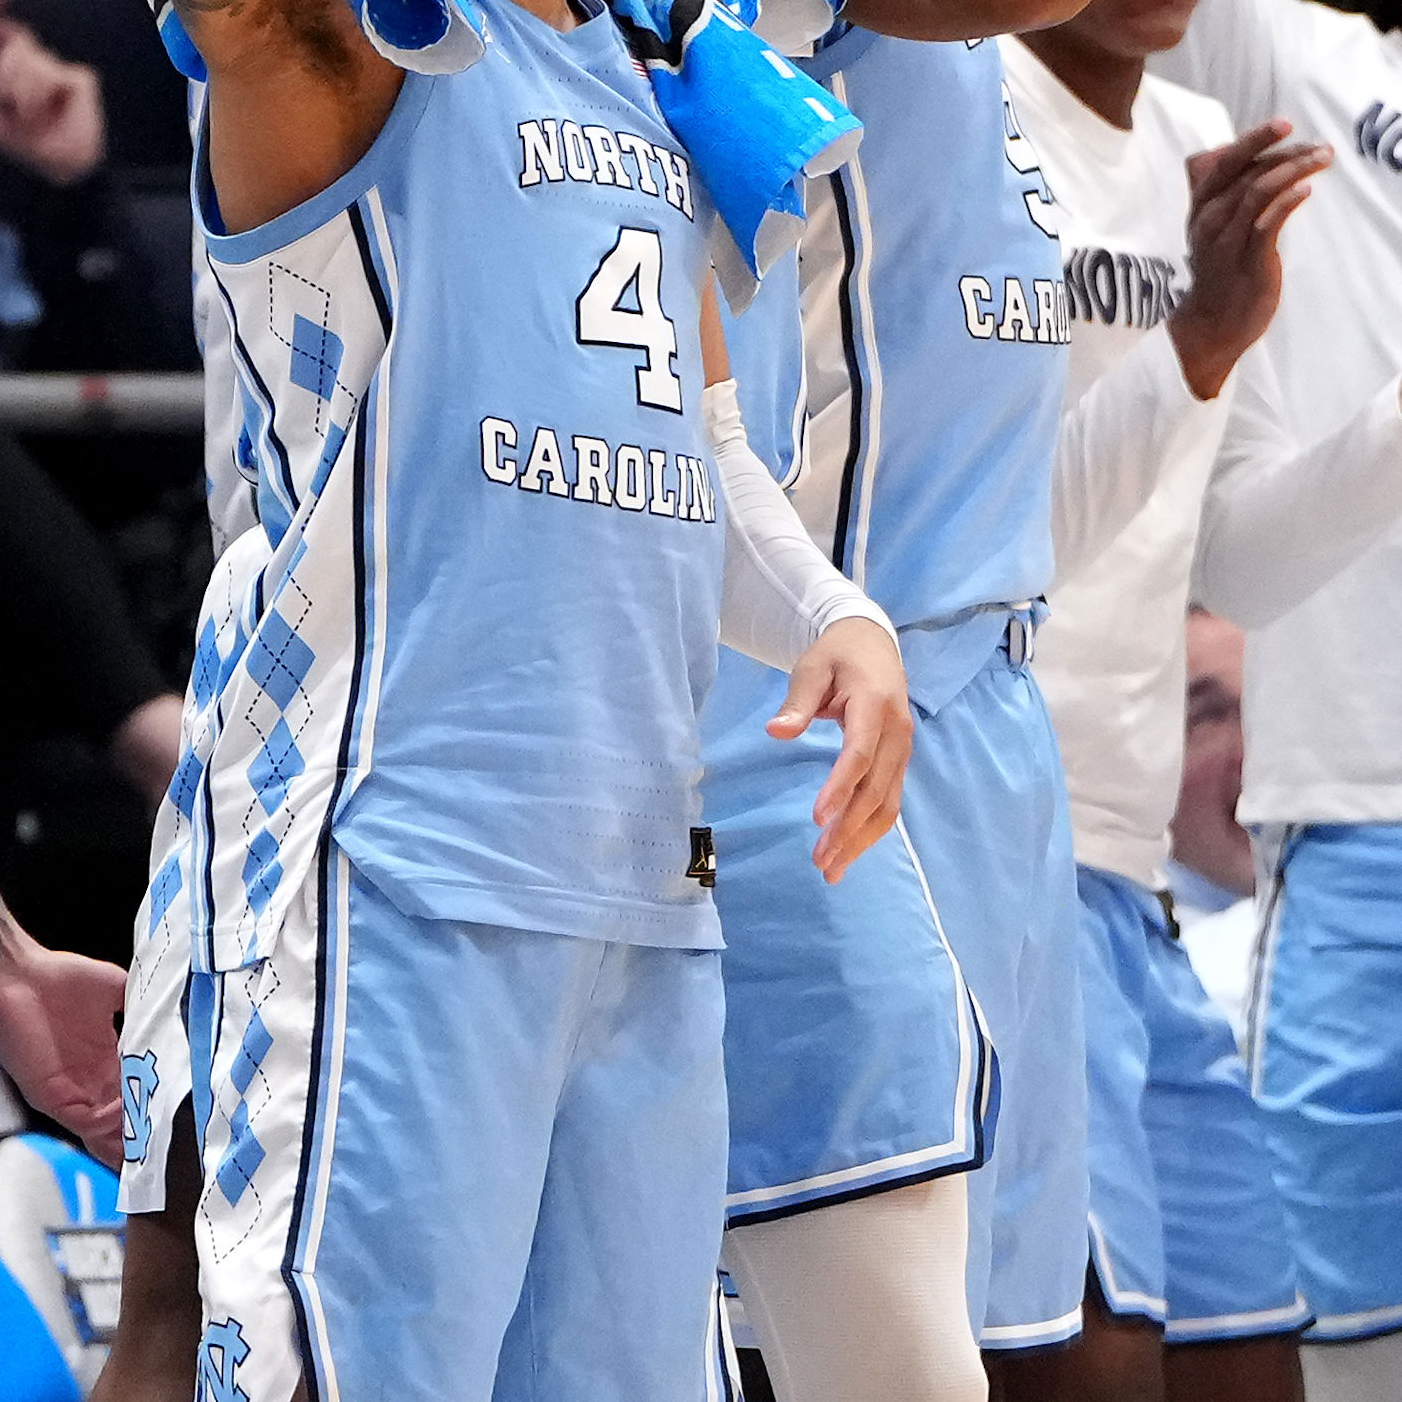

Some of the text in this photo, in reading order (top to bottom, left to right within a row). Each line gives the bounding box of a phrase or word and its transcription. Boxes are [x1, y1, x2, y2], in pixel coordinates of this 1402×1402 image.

[518, 118, 695, 223] NORTH
[575, 225, 684, 416] 4
[479, 415, 717, 524] CAROLIN
